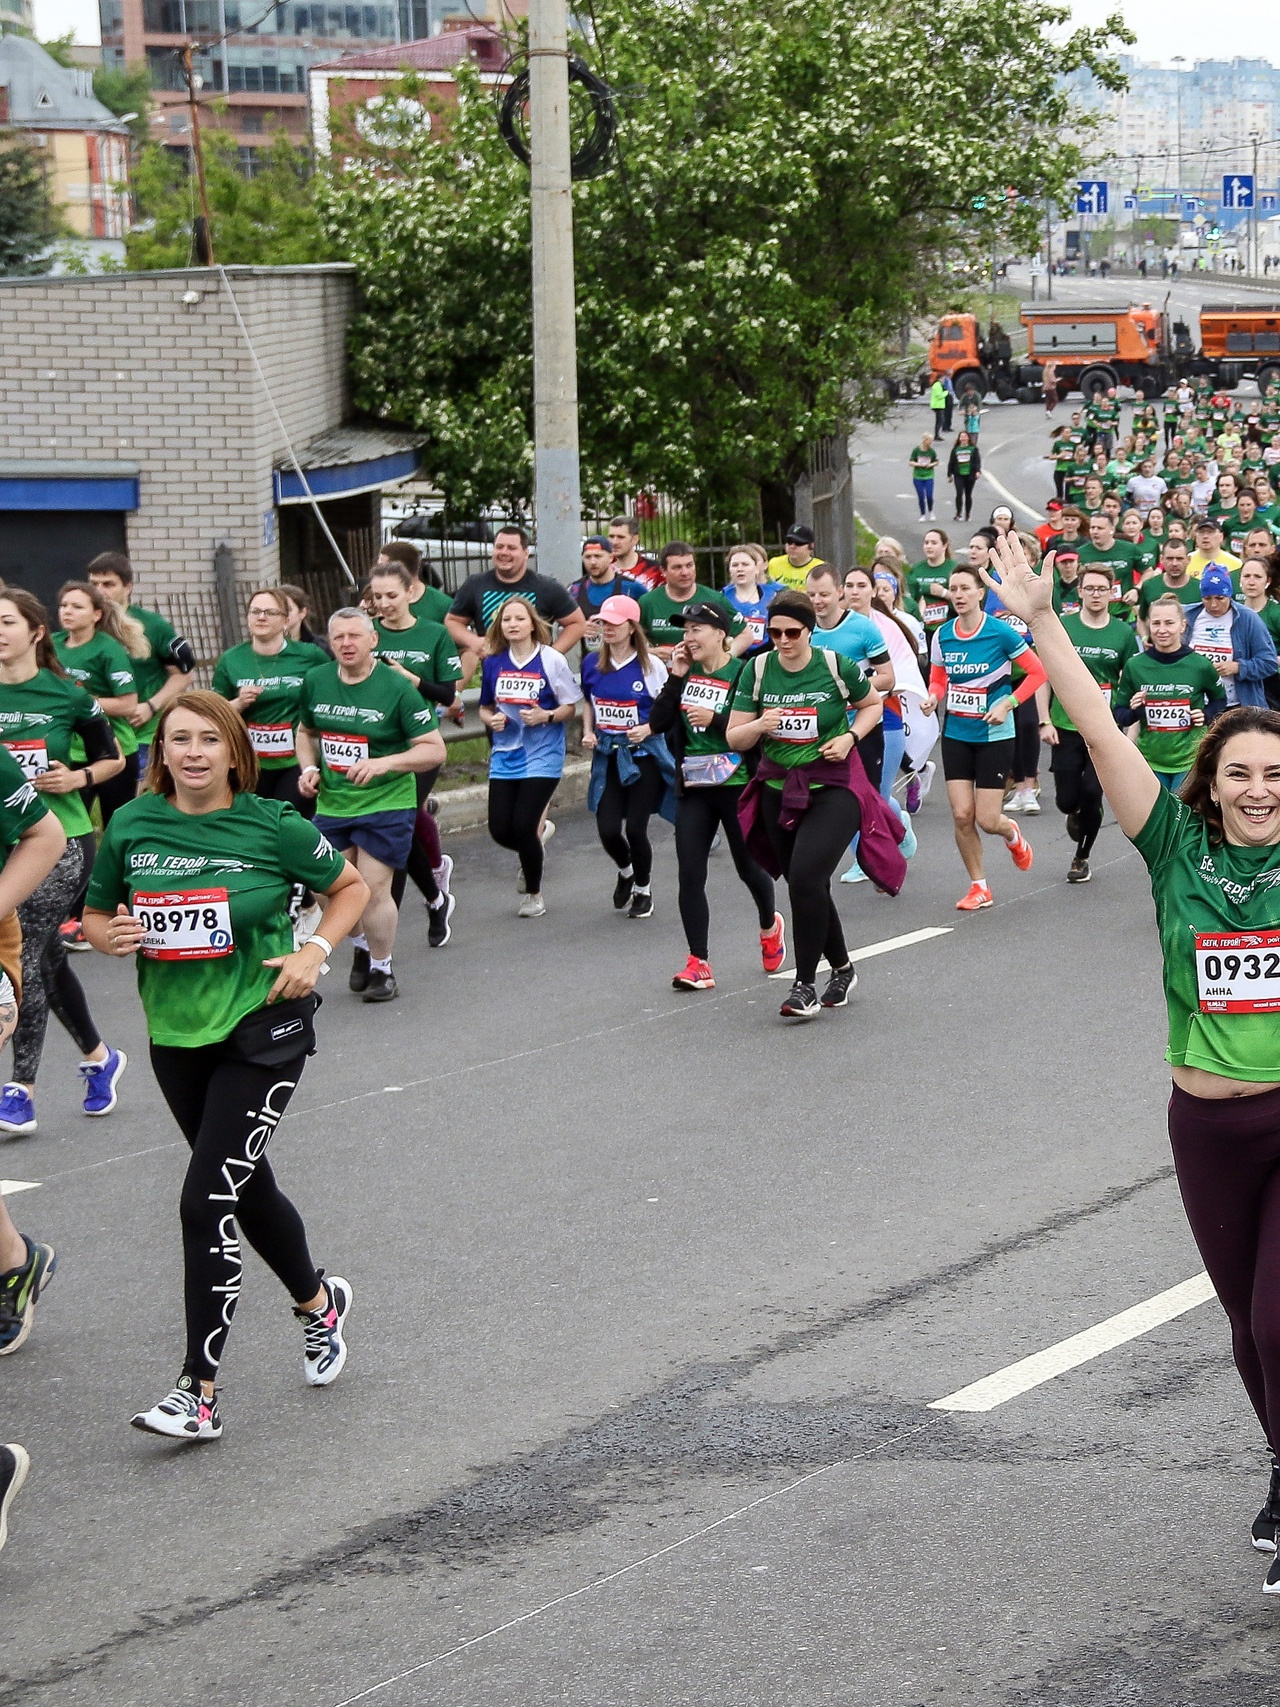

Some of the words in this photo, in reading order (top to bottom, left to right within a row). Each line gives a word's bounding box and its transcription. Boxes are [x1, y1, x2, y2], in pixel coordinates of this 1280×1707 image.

[945, 652, 968, 663] БЕГУ
[953, 663, 989, 674] СИБУР
[500, 679, 534, 691] 10379
[686, 685, 721, 702] 08631
[951, 693, 980, 706] 12481
[0, 710, 23, 723] ЕРОЙ!
[599, 707, 633, 719] 10404
[1149, 708, 1185, 719] 09262
[777, 718, 811, 731] 8637
[250, 732, 287, 744] 12344
[324, 742, 361, 757] 08463
[130, 853, 159, 869] БЕГИ,
[162, 856, 209, 869] ГЕРОЙ!
[139, 908, 218, 933] 08978
[214, 932, 227, 947] D
[1205, 987, 1233, 996] АННА
[208, 1080, 296, 1202] Klein
[203, 1213, 243, 1367] Calvin
